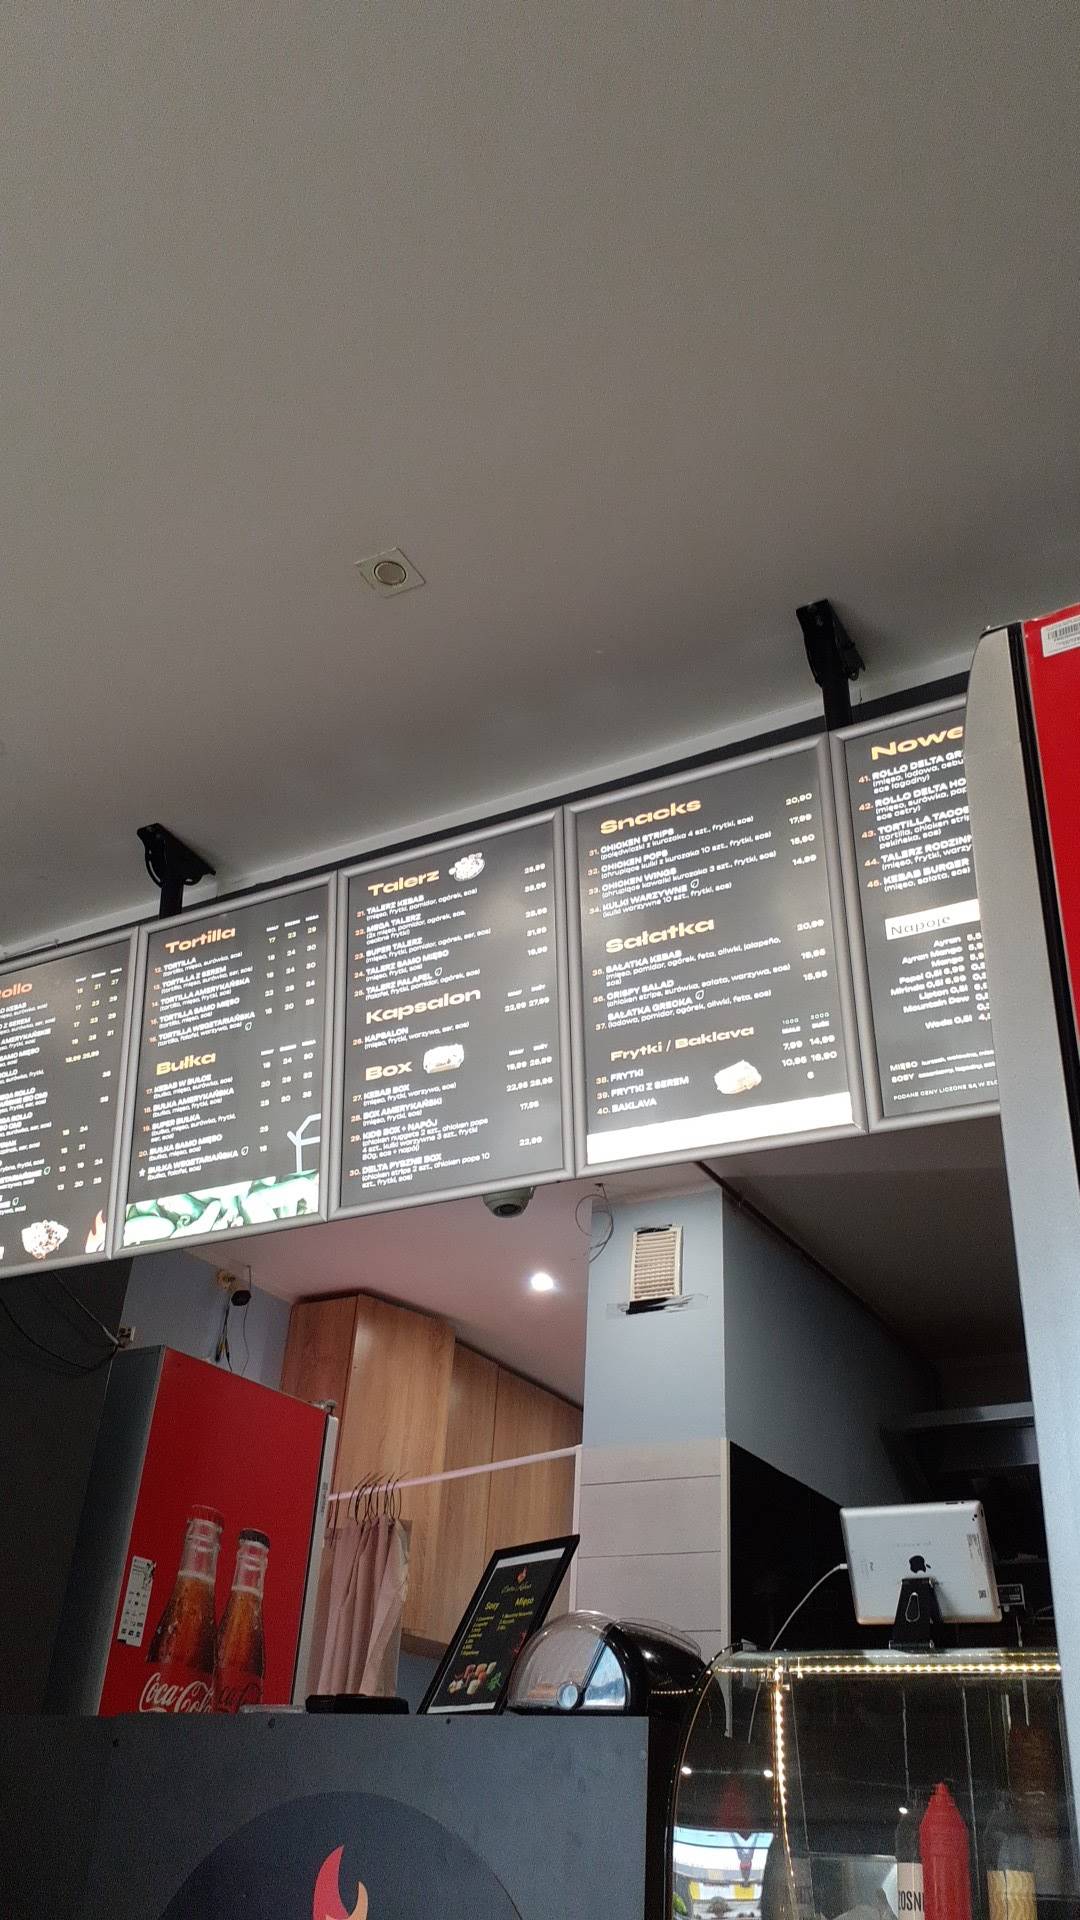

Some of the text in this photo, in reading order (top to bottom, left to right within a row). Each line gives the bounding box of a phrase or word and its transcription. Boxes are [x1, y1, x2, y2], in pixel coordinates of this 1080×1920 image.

[872, 764, 908, 780] ROLLO
[910, 755, 944, 770] DELTA
[945, 750, 963, 761] GR
[875, 792, 912, 808] ROLLO
[913, 783, 948, 798] DELTA
[601, 800, 701, 834] Snacks
[877, 815, 931, 834] TORTILLA
[600, 837, 641, 853] CHICKEN
[642, 828, 674, 842] STRIPS
[601, 856, 642, 872] CHICKEN
[643, 849, 668, 862] POPS
[881, 846, 923, 863] TALERZ
[602, 875, 643, 892] CHICKEN
[644, 867, 677, 881] WINGS
[883, 869, 922, 885] KEBAB
[923, 858, 969, 876] BURGER
[367, 870, 440, 896] Talerz
[366, 901, 396, 915] TALERZ
[397, 895, 424, 907] KEBAB
[602, 898, 629, 911] KULKI
[630, 884, 688, 904] WARZYWNE
[391, 913, 421, 926] TALERZ
[165, 926, 236, 955] Tortilla
[392, 937, 423, 950] TALERZ
[606, 919, 714, 953] Sałatka
[366, 962, 396, 975] TALERZ
[606, 950, 682, 973] SAŁATKA KEBAB
[0, 982, 33, 999] ollo
[366, 981, 396, 995] TALERZ
[606, 979, 674, 1000] CRISPY SALAD
[366, 989, 481, 1024] Kapsalon
[607, 1005, 651, 1021] SAŁATKA
[365, 1027, 409, 1043] KAPSALON
[611, 1041, 663, 1061] Frytki
[675, 1027, 754, 1049] Baklava
[156, 1052, 217, 1077] Bułka
[365, 1061, 412, 1081] Box
[610, 1069, 644, 1082] FRYTKI
[392, 1084, 410, 1094] BOX
[611, 1084, 645, 1097] FRYTKI
[646, 1082, 653, 1091] Z
[654, 1076, 689, 1089] SEREM
[363, 1110, 380, 1120] BOX
[597, 1097, 657, 1115] 40. BAKLAVA
[383, 1126, 401, 1136] BOX
[424, 1153, 442, 1163] BOX
[140, 1672, 214, 1713] Coca-Cola
